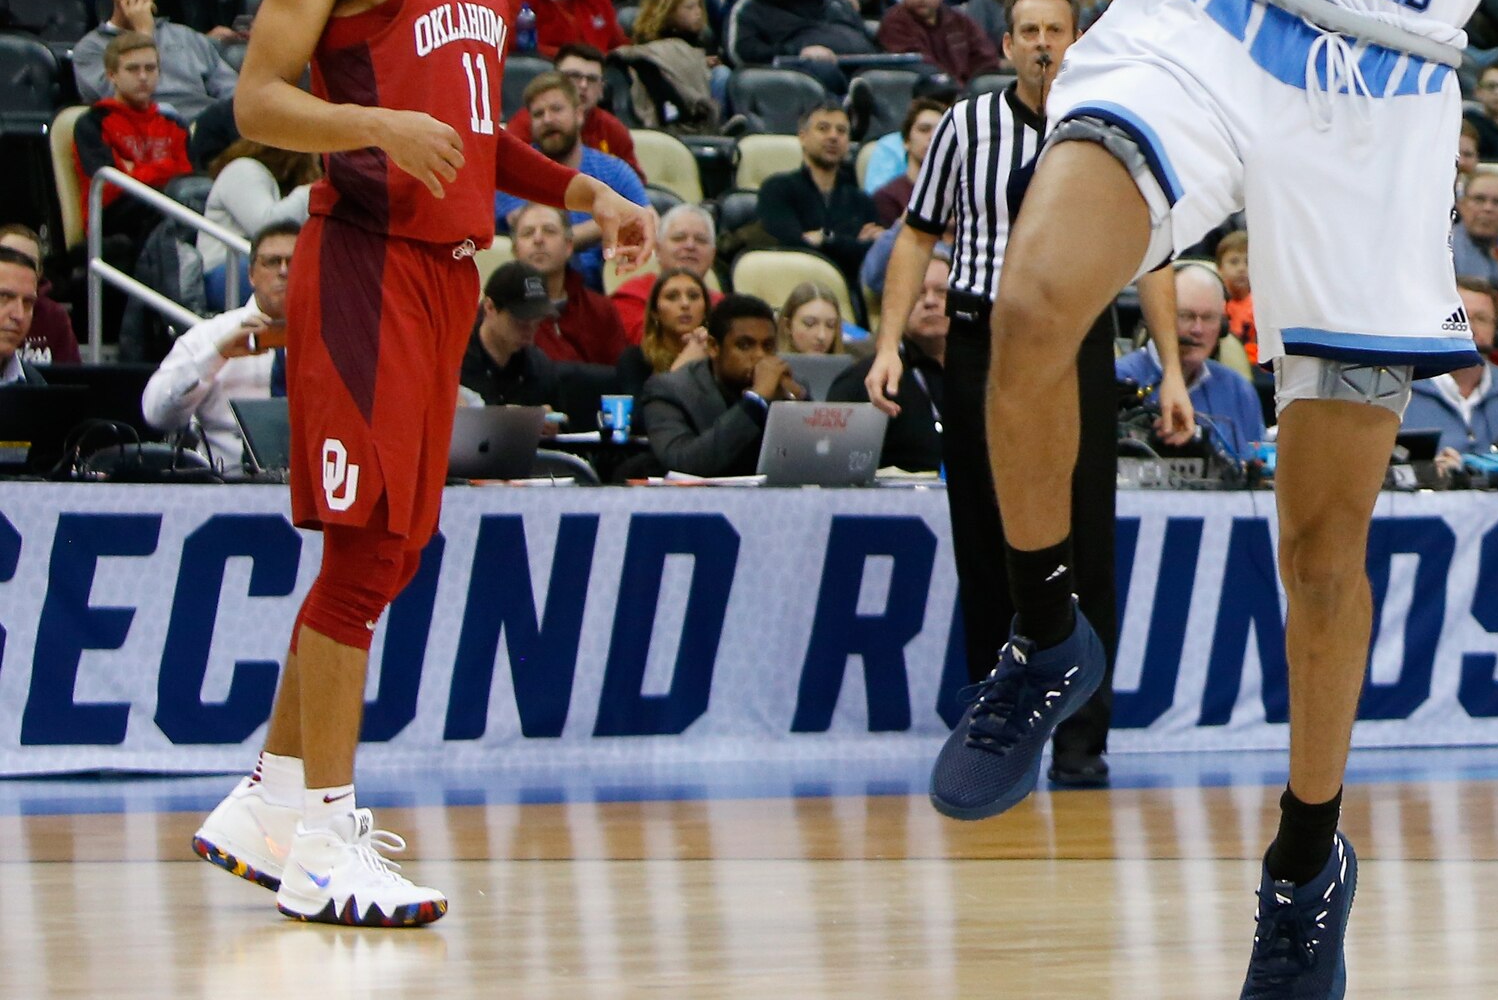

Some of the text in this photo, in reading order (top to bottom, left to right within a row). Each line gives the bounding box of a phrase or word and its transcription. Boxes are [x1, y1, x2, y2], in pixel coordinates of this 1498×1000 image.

[414, 3, 508, 62] OKLAHOM
[462, 52, 494, 135] 11
[322, 438, 360, 511] OU
